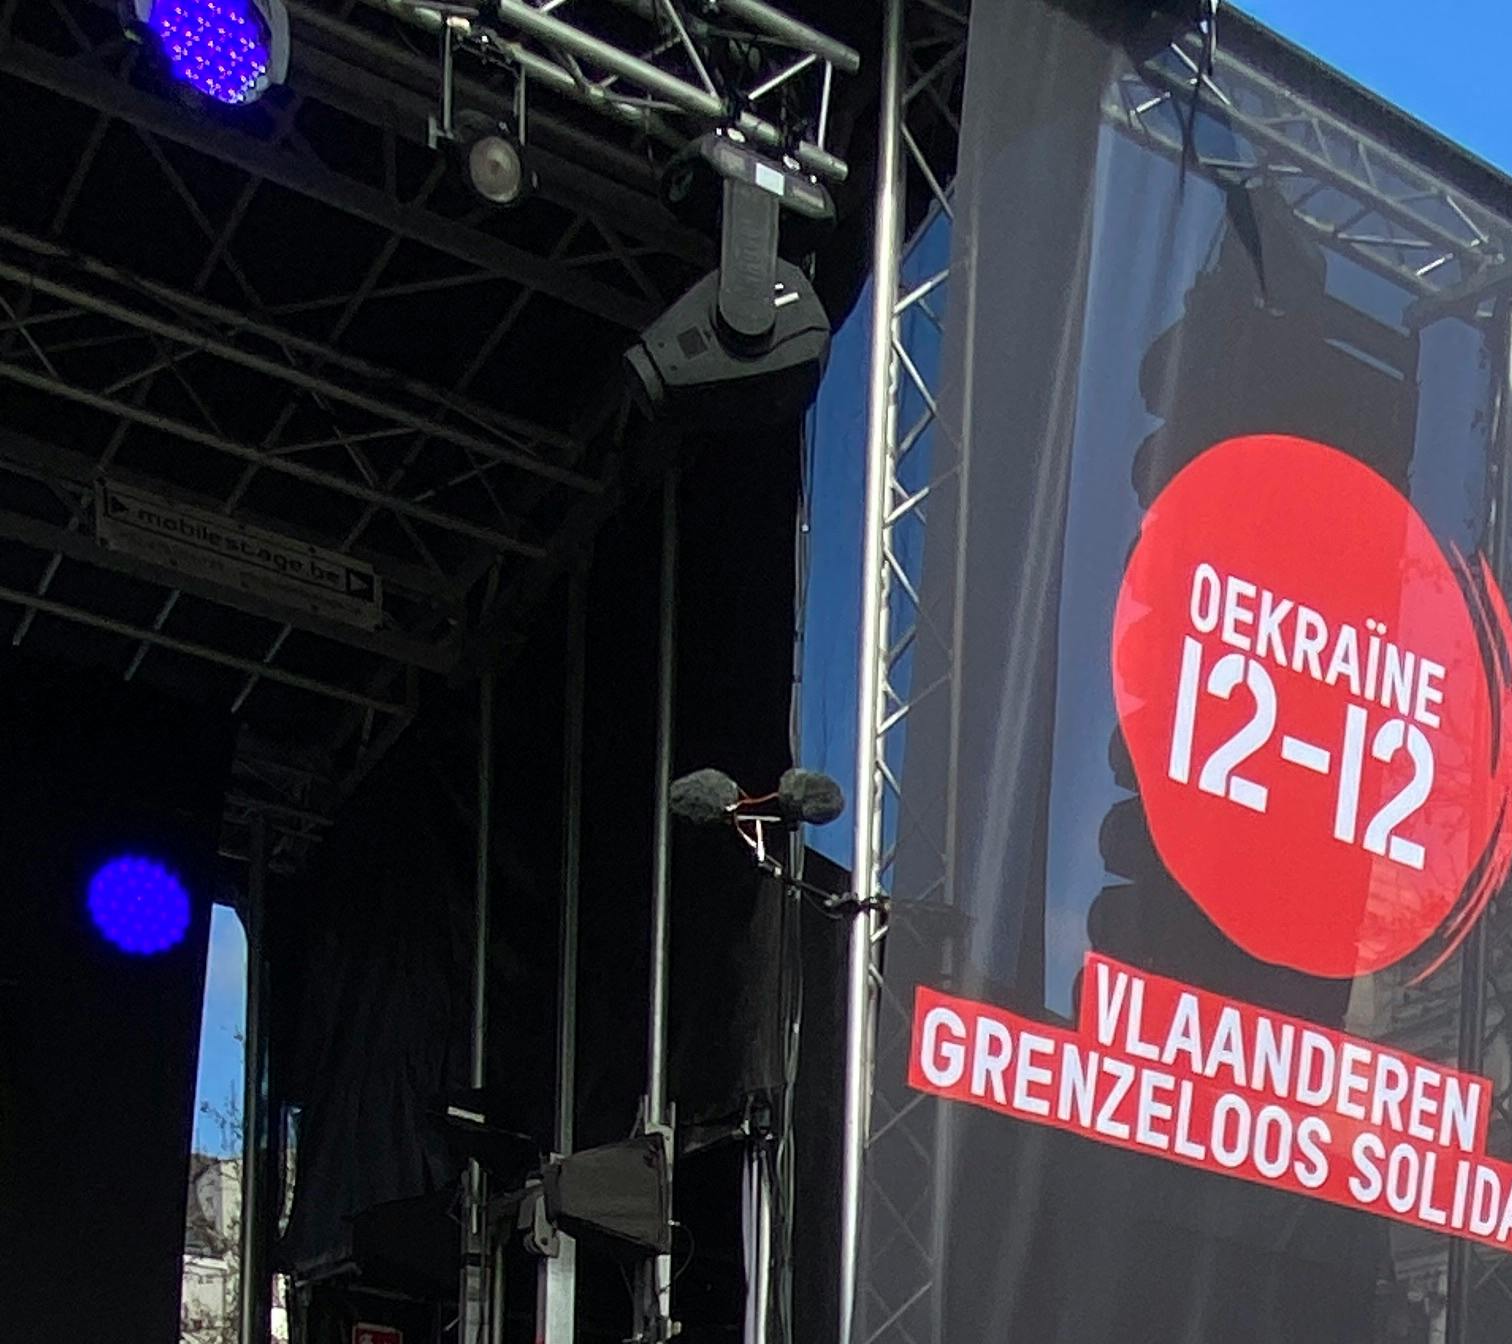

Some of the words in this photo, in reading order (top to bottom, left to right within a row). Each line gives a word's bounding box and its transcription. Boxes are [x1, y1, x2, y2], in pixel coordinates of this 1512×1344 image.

[1190, 563, 1446, 728] OEKRAÏNE
[1168, 635, 1435, 870] 12-12
[920, 1007, 1332, 1188] GRENZELOOS
[1096, 962, 1481, 1151] VLAANDEREN
